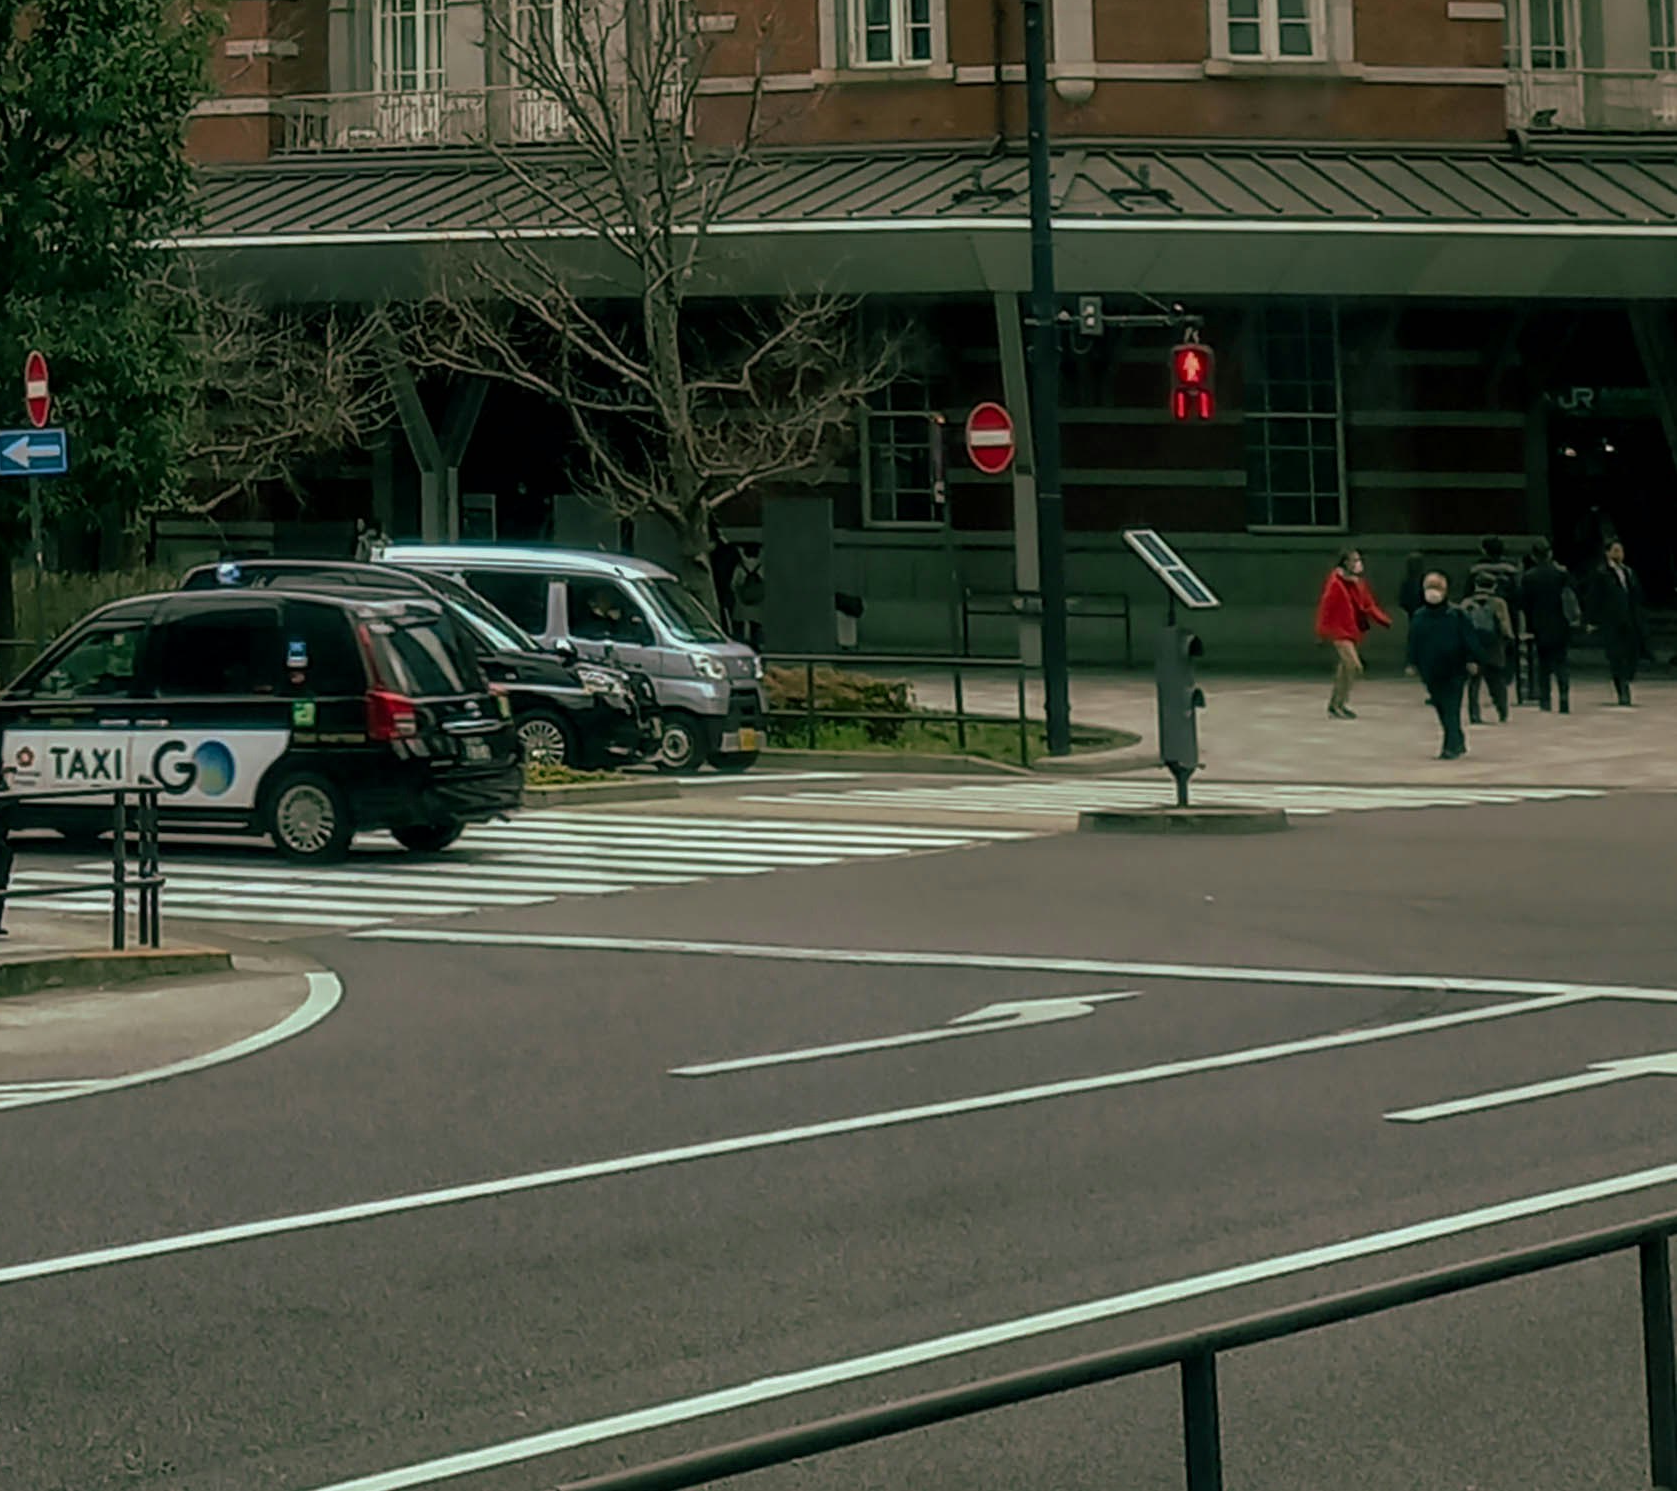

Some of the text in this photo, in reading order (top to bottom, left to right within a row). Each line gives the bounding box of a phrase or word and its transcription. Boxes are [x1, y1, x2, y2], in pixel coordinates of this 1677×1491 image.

[1558, 386, 1595, 410] JR
[49, 739, 236, 797] TAXI GO
